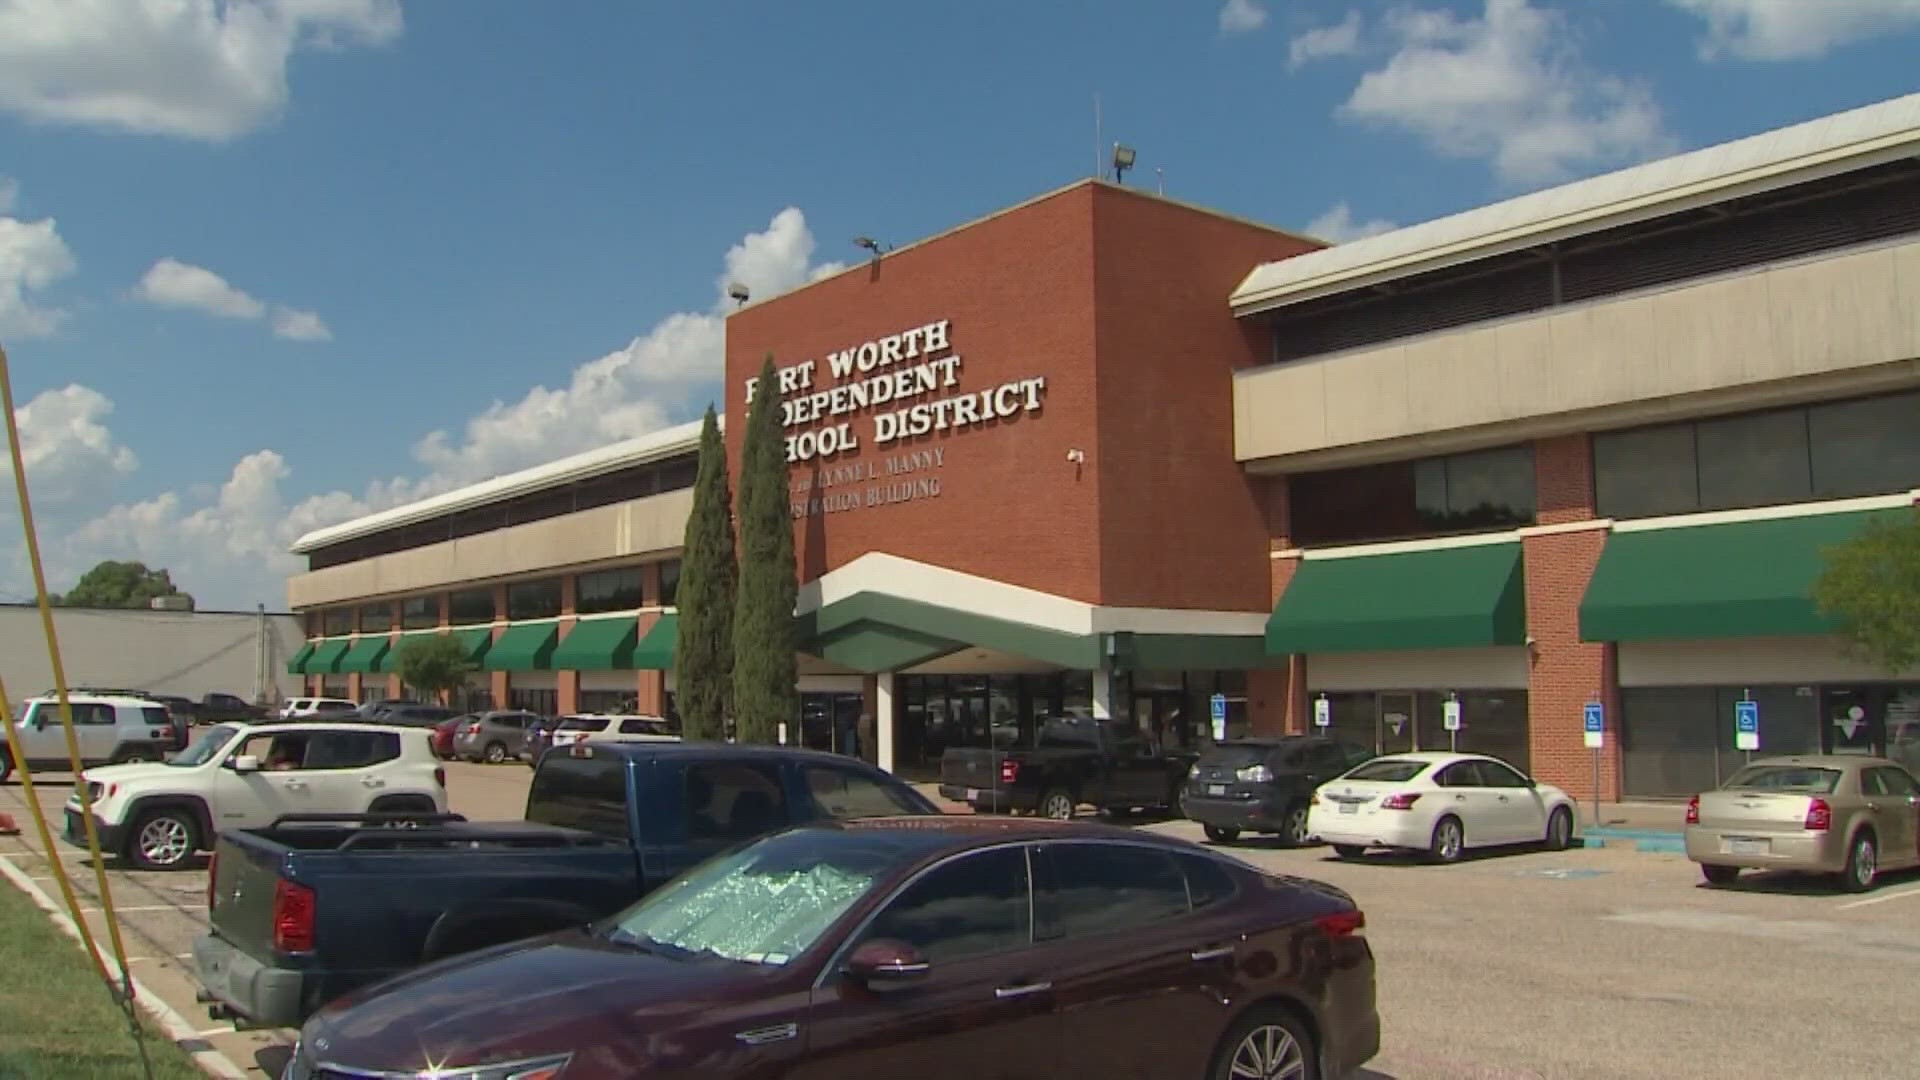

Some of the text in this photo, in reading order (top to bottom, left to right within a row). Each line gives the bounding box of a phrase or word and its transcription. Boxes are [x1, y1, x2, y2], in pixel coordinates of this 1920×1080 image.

[744, 319, 949, 404] FRT WORTH
[745, 355, 961, 427] DEPENDENT
[784, 376, 1044, 462] HOOL DISTRICT
[867, 477, 941, 507] BUILDING
[886, 447, 945, 475] MANNY
